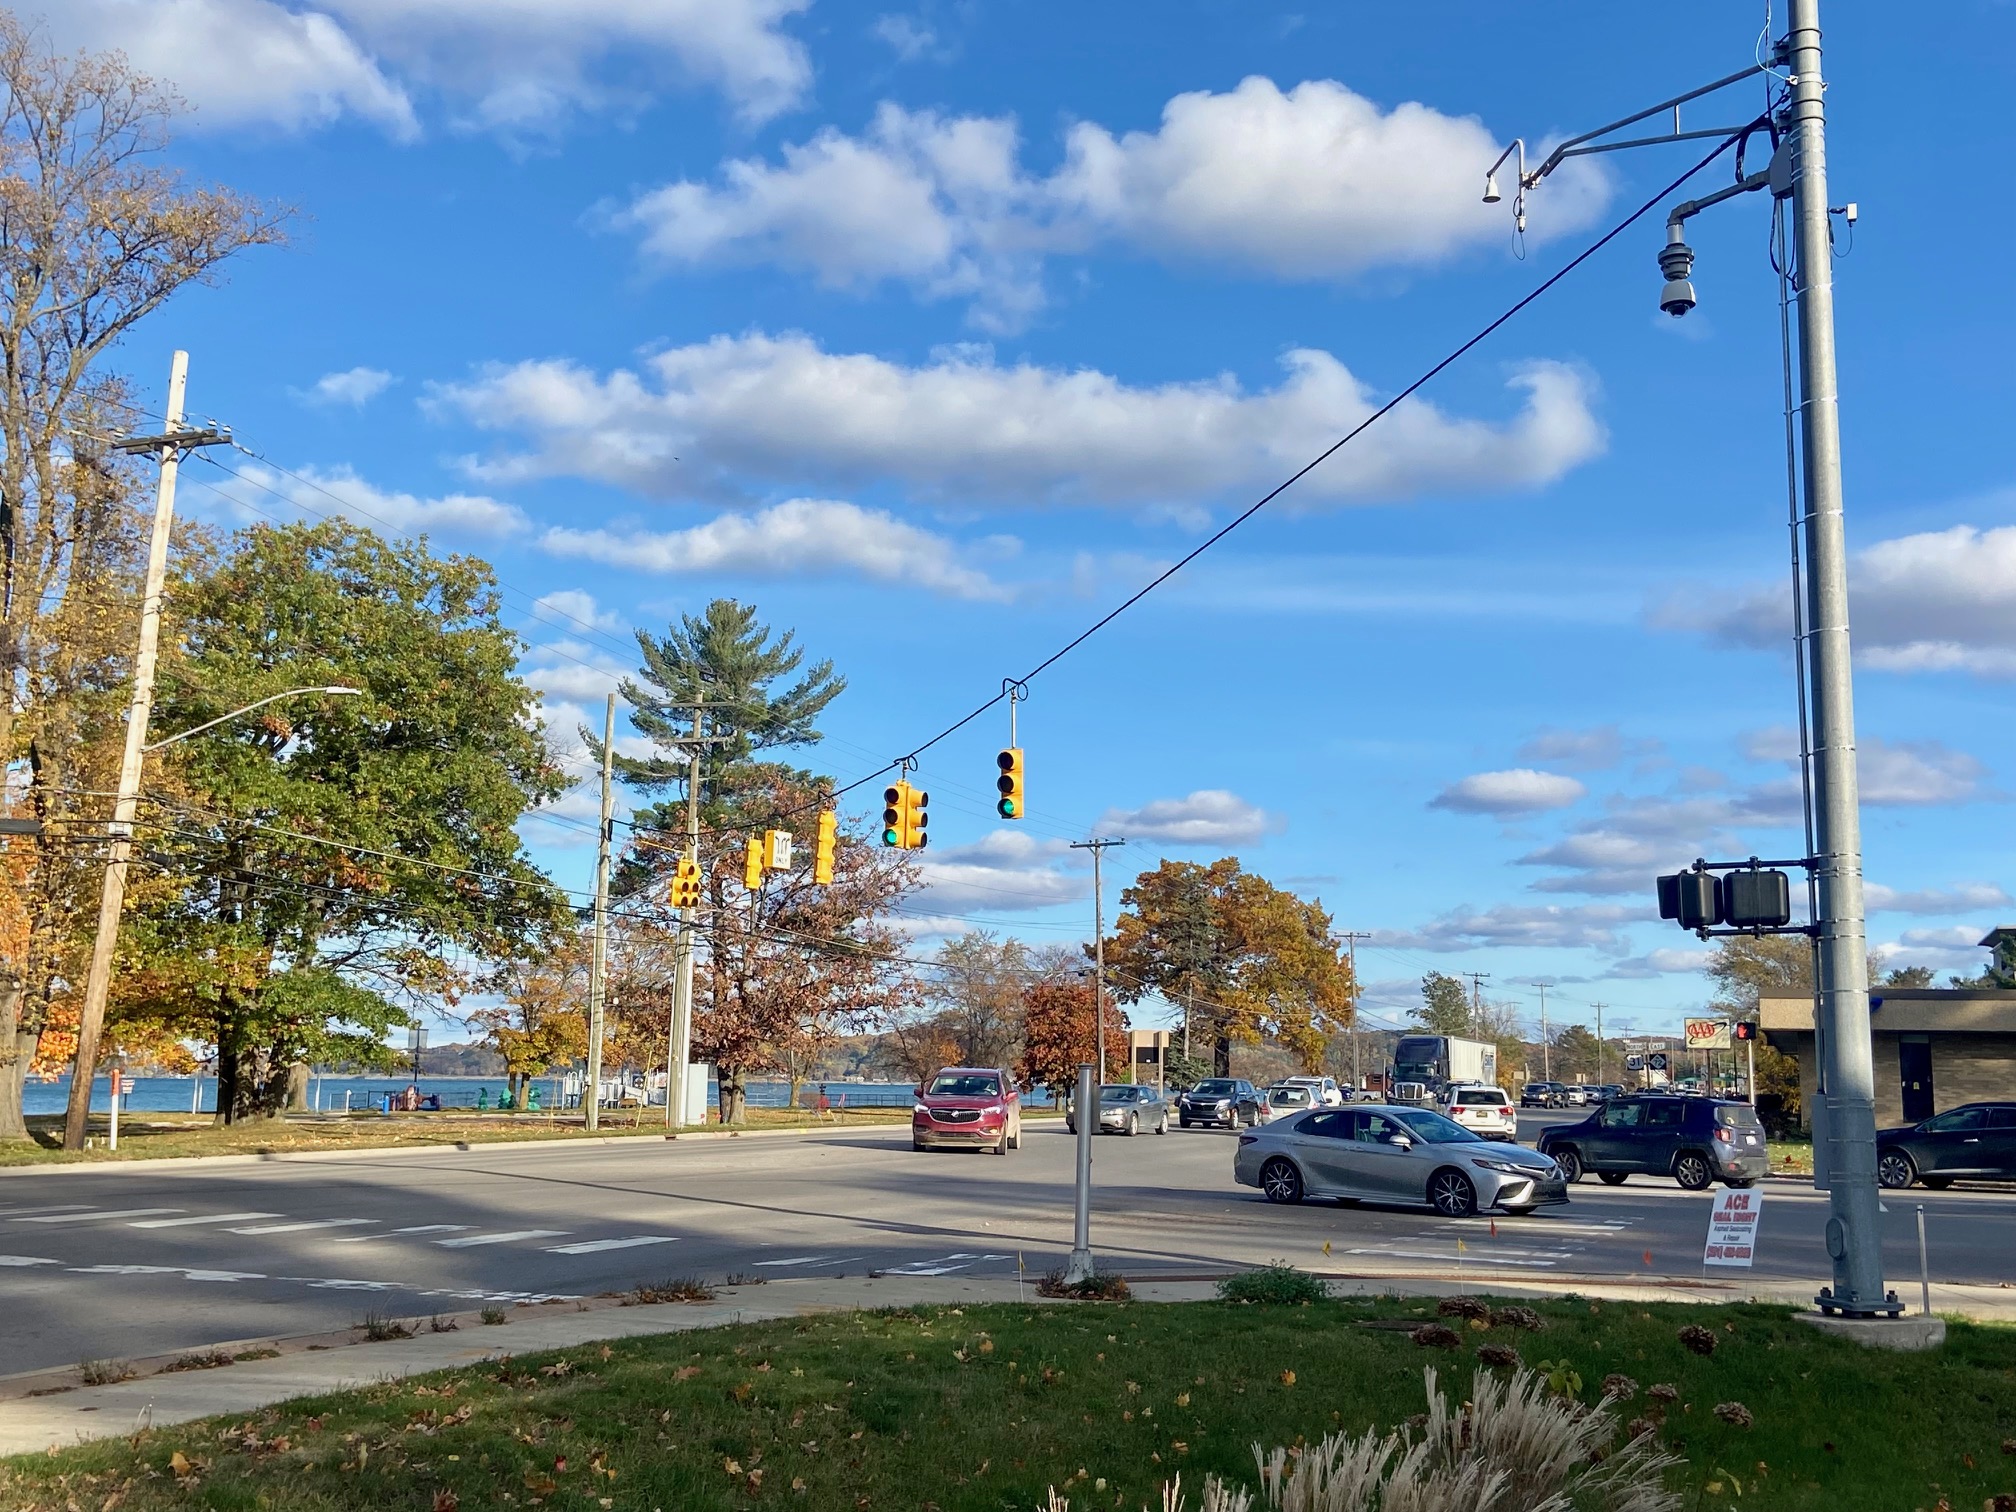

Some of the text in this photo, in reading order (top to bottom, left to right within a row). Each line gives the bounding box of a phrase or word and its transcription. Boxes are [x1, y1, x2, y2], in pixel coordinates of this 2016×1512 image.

[1689, 1023, 1714, 1038] AAA
[1629, 1057, 1641, 1067] 31
[1724, 1194, 1750, 1210] ACE
